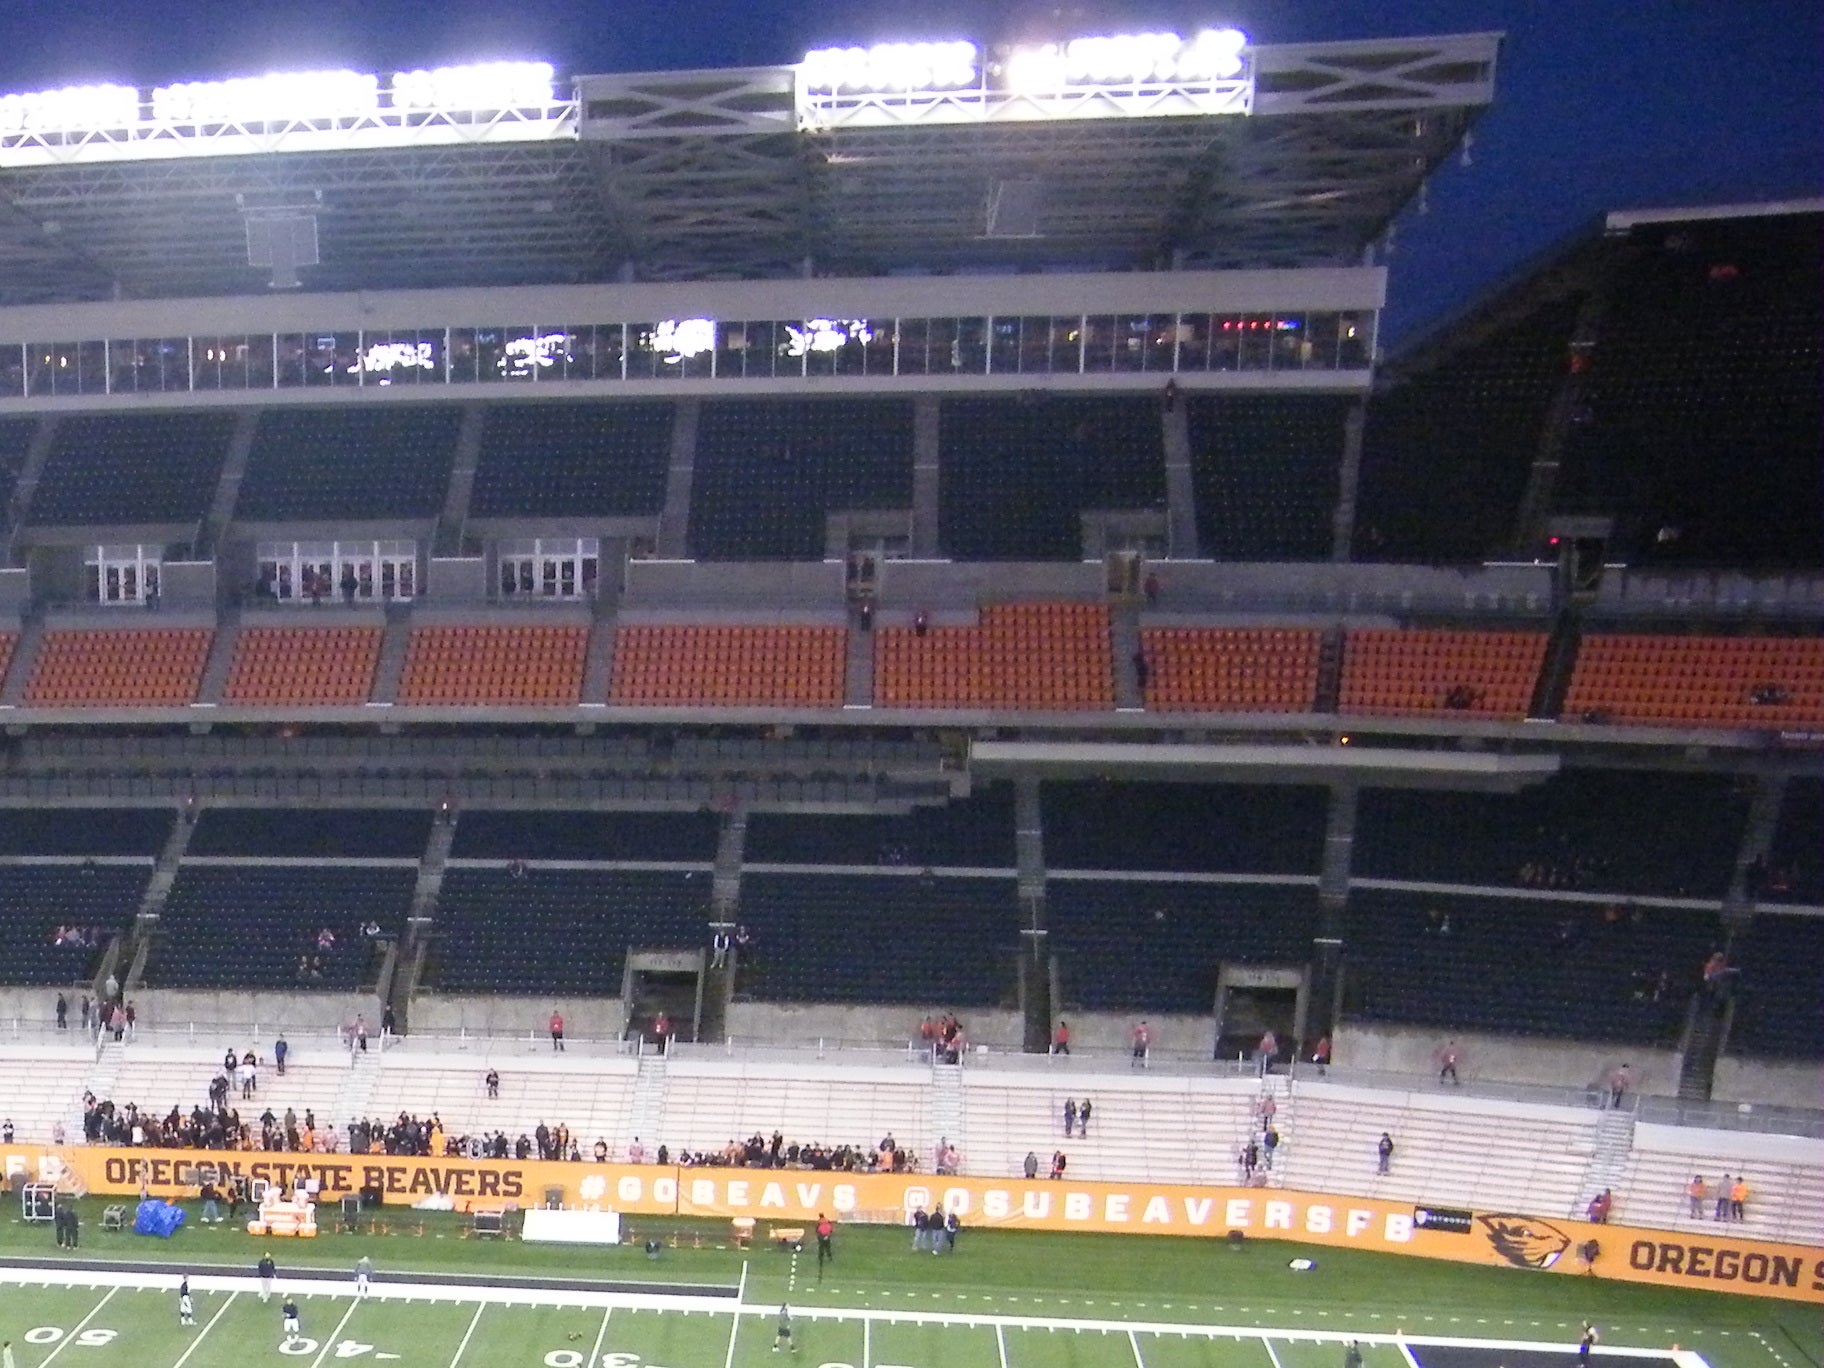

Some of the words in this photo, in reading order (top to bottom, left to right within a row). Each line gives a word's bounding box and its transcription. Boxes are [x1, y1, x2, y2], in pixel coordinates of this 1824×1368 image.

[363, 1165, 523, 1198] BEAVERS
[580, 1174, 856, 1210] #GOBEAVS
[903, 1184, 1414, 1243] @OSUBEAVERSFB
[1629, 1240, 1803, 1288] OREGON
[24, 1326, 119, 1347] 50
[279, 1338, 373, 1359] 40
